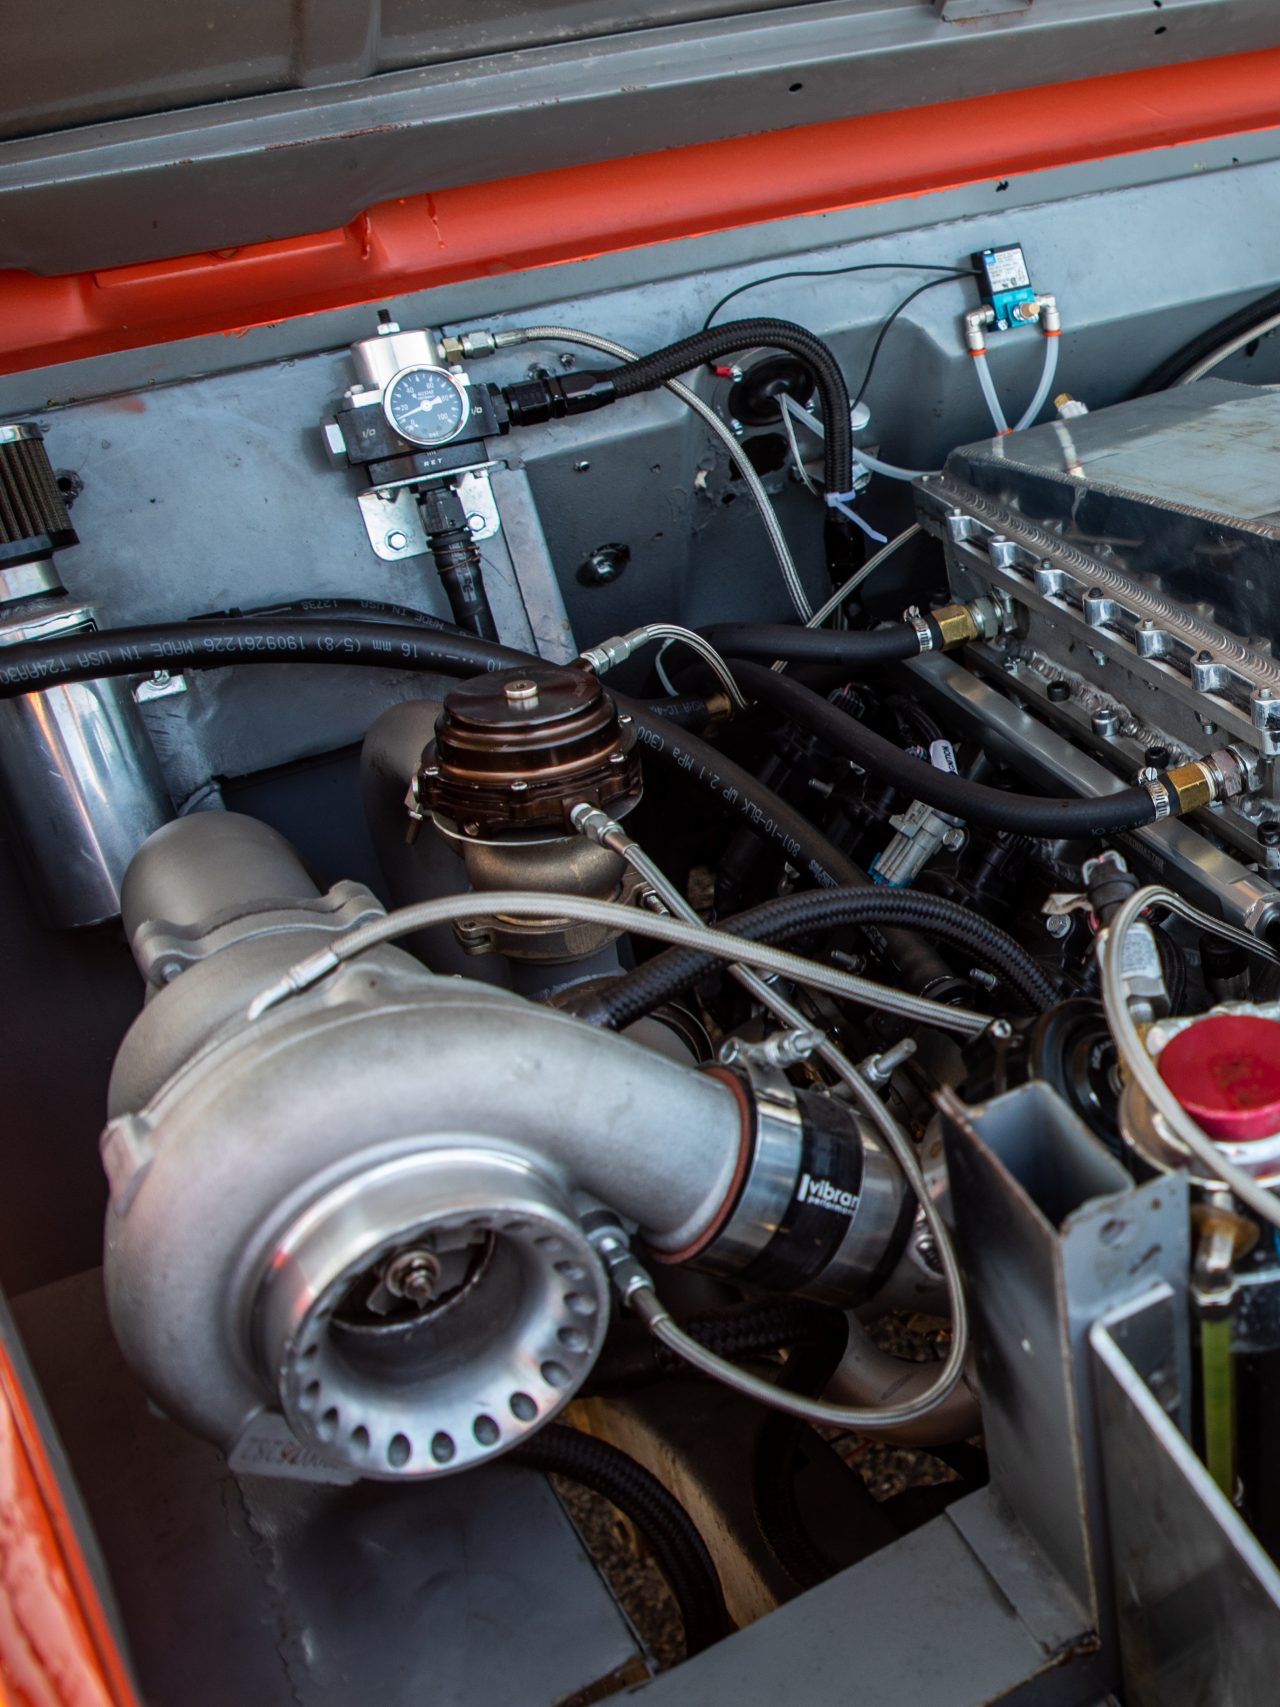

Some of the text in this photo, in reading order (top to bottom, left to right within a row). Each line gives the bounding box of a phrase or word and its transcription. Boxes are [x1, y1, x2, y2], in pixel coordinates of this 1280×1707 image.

[423, 457, 444, 467] RET
[360, 600, 385, 611] USA
[391, 605, 407, 617] IN
[413, 612, 445, 631] MADE
[150, 638, 194, 658] MADE
[203, 634, 305, 652] 1909261226
[317, 635, 361, 652] (5/8)
[373, 639, 392, 656] mm
[400, 641, 419, 659] 16
[75, 648, 110, 667] USA
[118, 644, 141, 661] IN
[672, 745, 694, 771] MPa
[699, 766, 721, 789] 2.1
[722, 786, 738, 804] WP
[739, 797, 801, 857] 801-10-BLK
